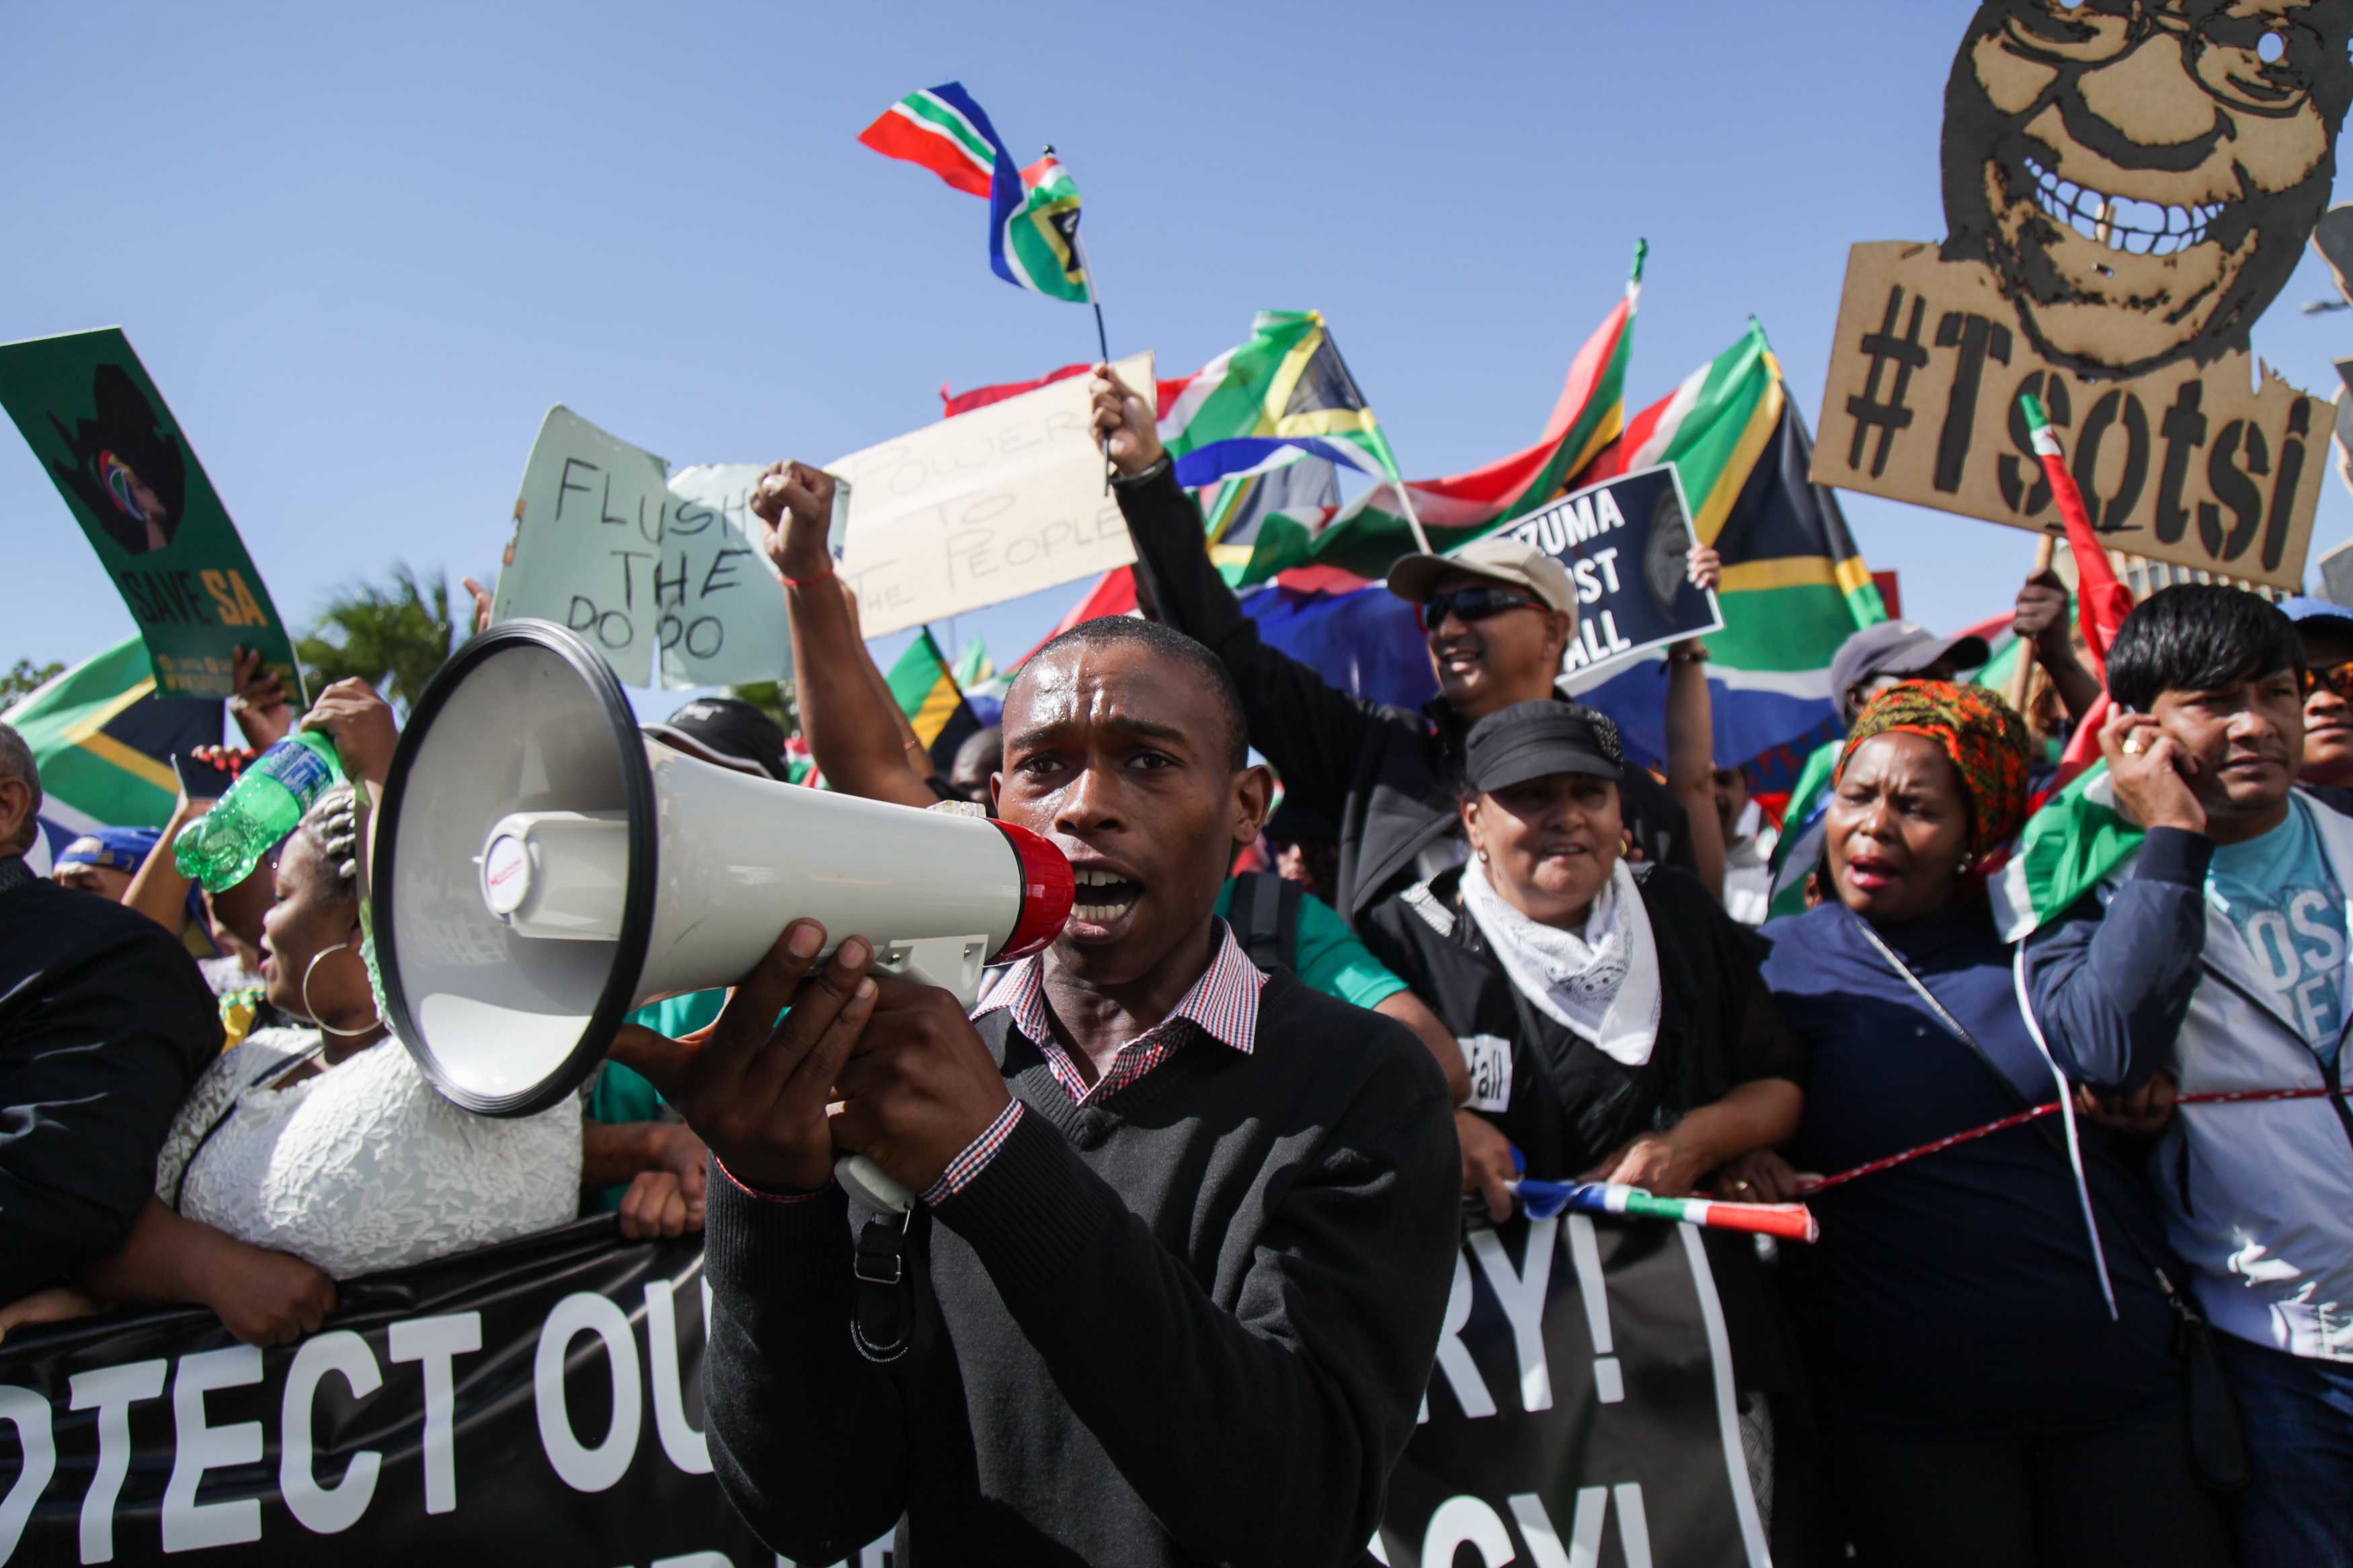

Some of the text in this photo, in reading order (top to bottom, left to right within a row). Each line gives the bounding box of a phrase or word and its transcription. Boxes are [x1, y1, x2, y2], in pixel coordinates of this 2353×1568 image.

[852, 411, 1086, 514] POWER
[555, 458, 749, 544] FLUSH
[895, 489, 1017, 528] TO
[1511, 488, 1626, 556] ZUMA
[610, 549, 752, 613] THE
[847, 504, 1128, 611] THE PEOPLE
[1564, 546, 1620, 604] ST
[121, 569, 268, 626] SAVE SA
